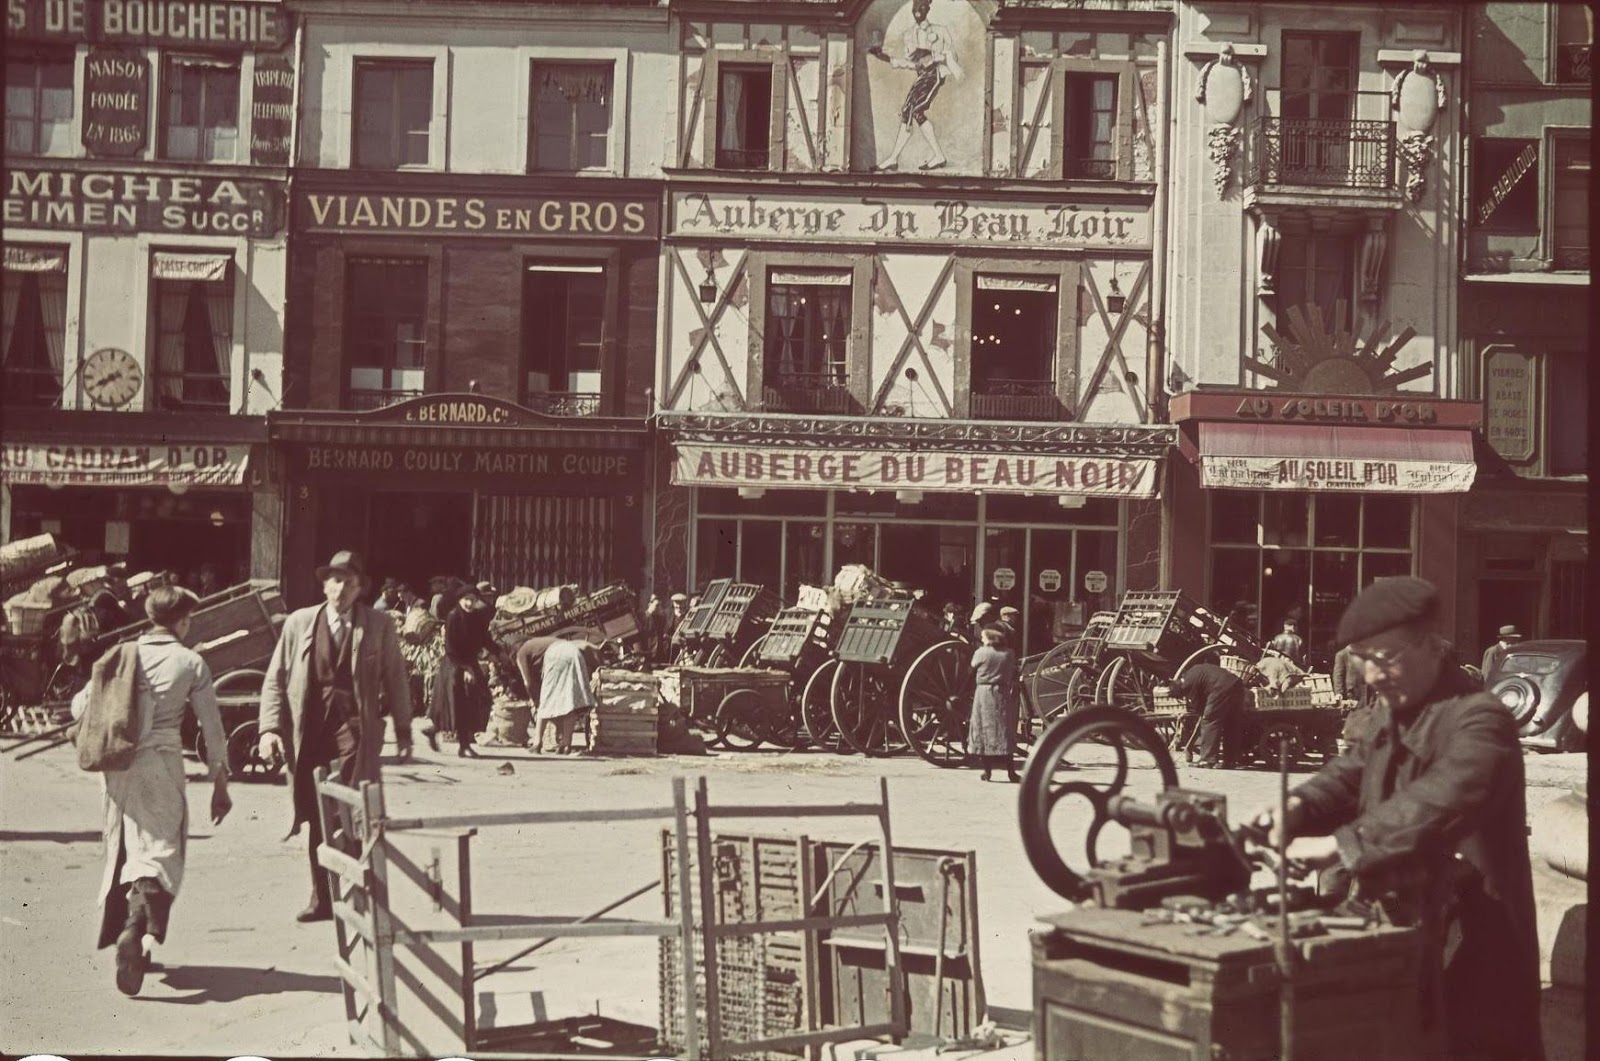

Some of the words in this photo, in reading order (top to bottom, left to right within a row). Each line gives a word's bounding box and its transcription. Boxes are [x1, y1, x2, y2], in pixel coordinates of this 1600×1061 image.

[45, 0, 84, 32] DE
[104, 0, 277, 42] BOUCHERIE
[89, 59, 145, 79] MAISON
[91, 90, 139, 111] FONDÉE
[308, 194, 487, 229] VIANDES
[496, 208, 532, 231] EN
[538, 200, 645, 234] GROS
[681, 193, 845, 235] Auberge
[934, 200, 1031, 238] Beau
[1044, 204, 1134, 240] Noir
[419, 402, 487, 422] BERNARD
[1236, 398, 1273, 416] AU
[1280, 399, 1367, 420] SOLEIL
[1375, 402, 1437, 423] D'OR
[47, 446, 150, 469] CADRAN
[167, 446, 228, 469] D'OR
[308, 448, 393, 470] BERNARD
[404, 450, 462, 471] COULY
[473, 453, 548, 474] MARTIN
[563, 454, 628, 475] COUPE
[697, 451, 861, 482] AUBERGE
[881, 455, 926, 483] DU
[945, 457, 1036, 486] BEAU
[1055, 461, 1138, 490] NOIR
[1278, 459, 1299, 484] AU
[1305, 460, 1358, 481] SOLEIL
[1363, 461, 1398, 486] D'OR
